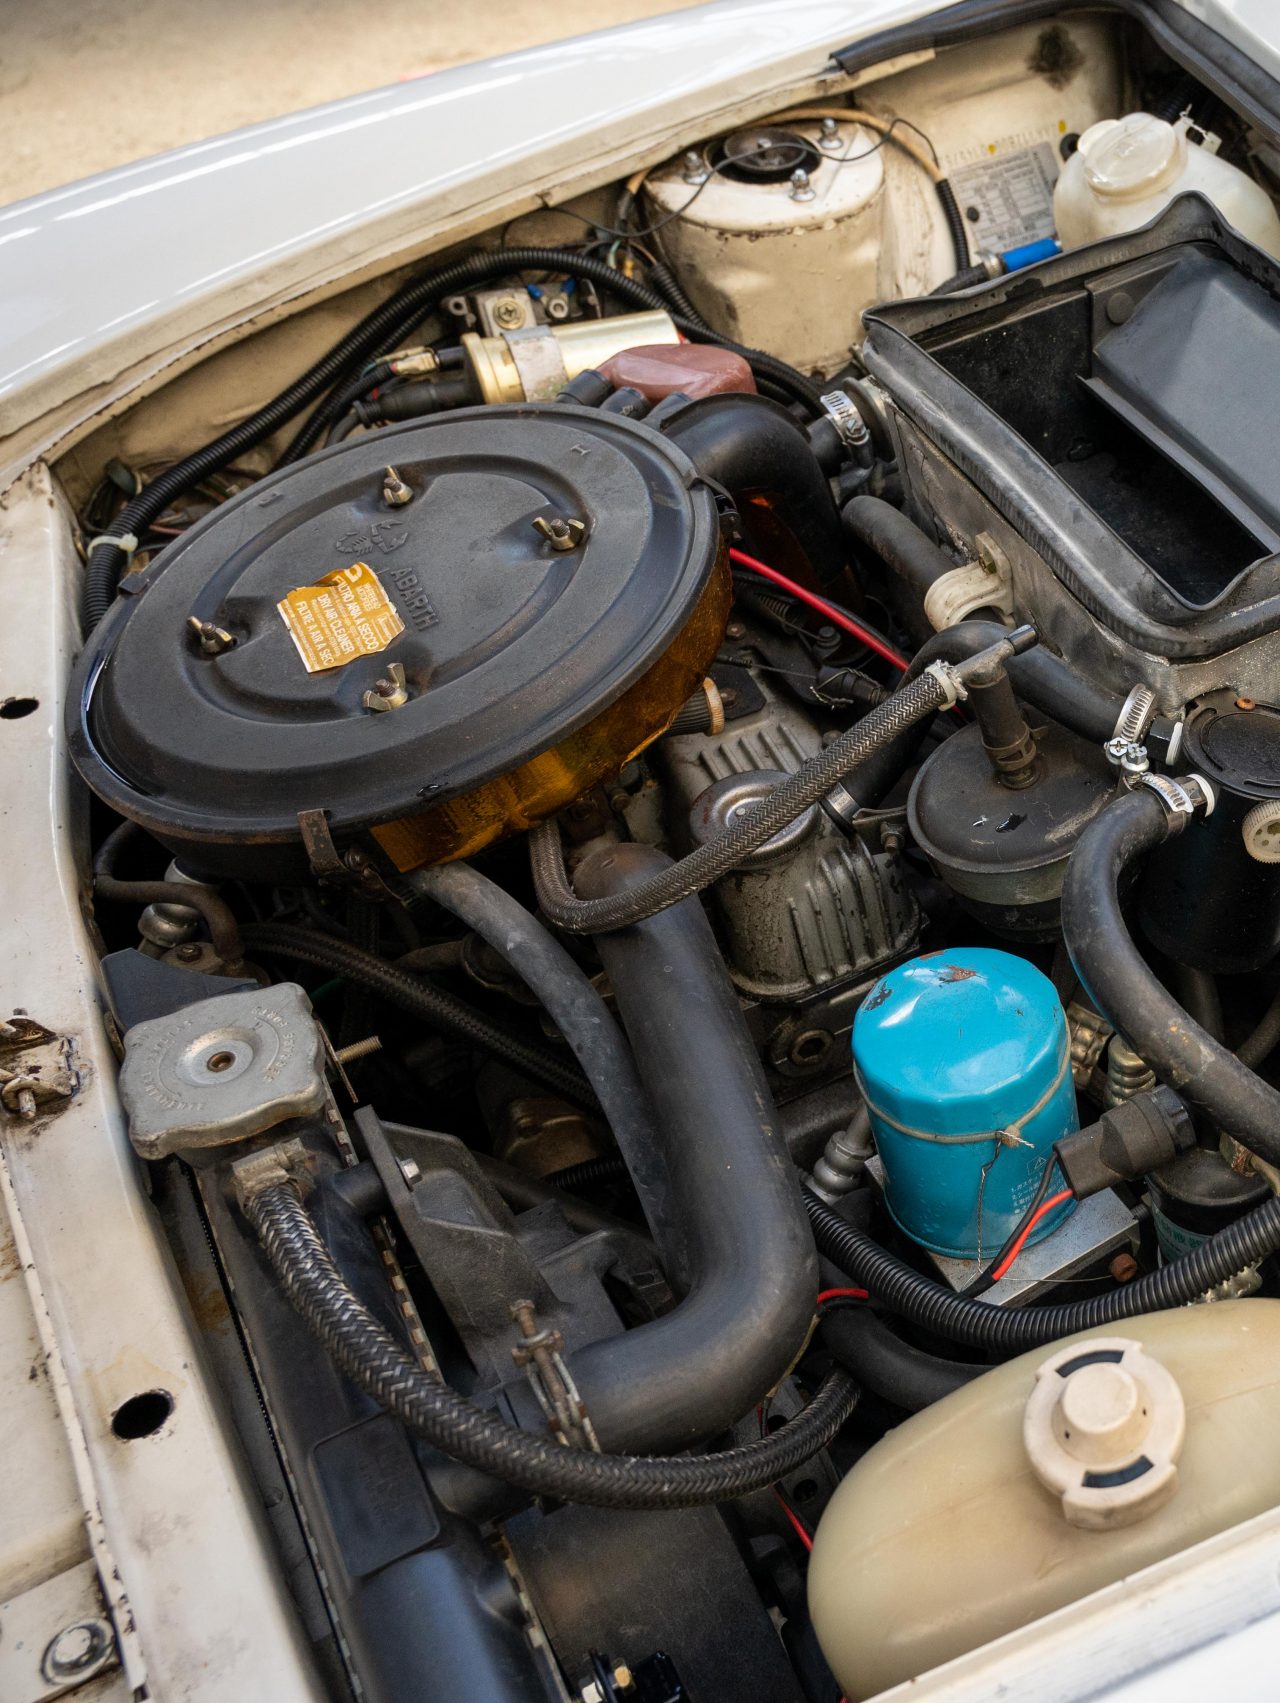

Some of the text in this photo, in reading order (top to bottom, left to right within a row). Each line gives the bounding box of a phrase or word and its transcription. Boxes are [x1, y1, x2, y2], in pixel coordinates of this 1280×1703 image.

[318, 593, 333, 611] DRY
[324, 607, 338, 621] AIR
[332, 575, 355, 604] FILTRO
[357, 620, 379, 650] SECCO
[390, 567, 439, 632] ABARTH
[295, 600, 314, 627] FILTRE
[319, 647, 335, 666] SEC
[330, 619, 355, 655] CLEANER
